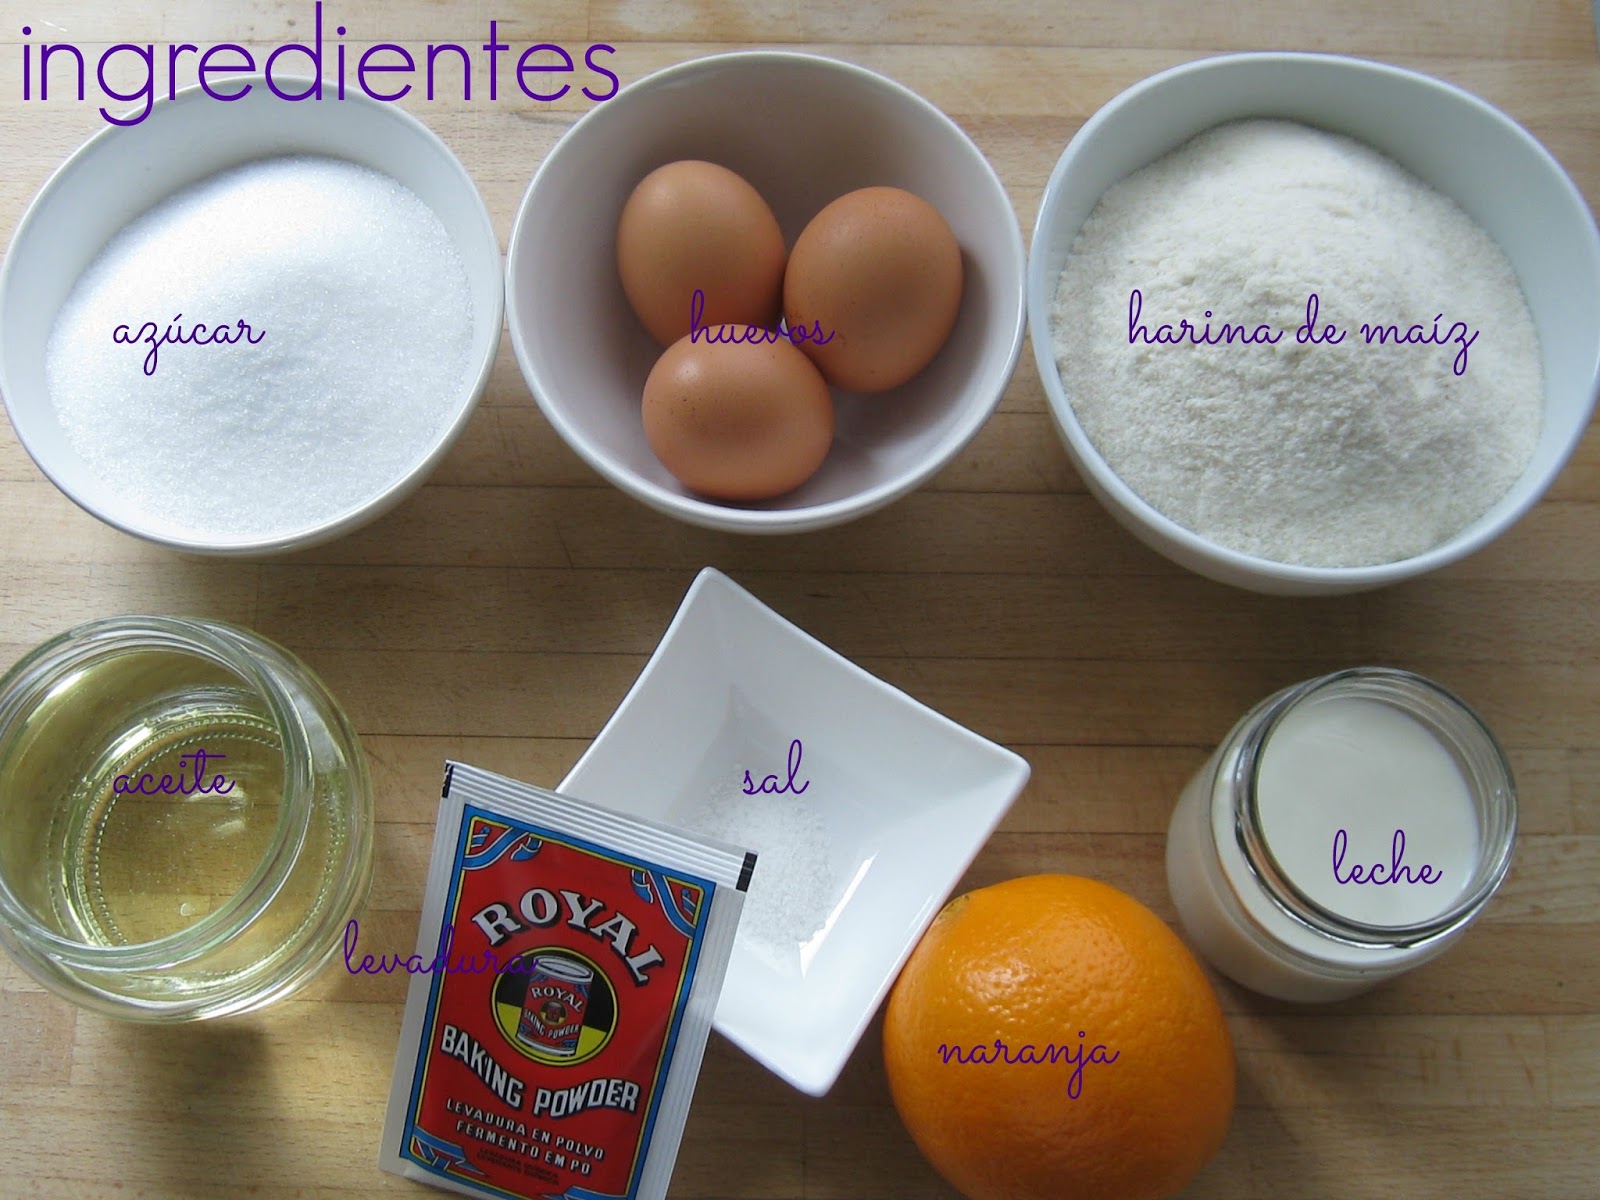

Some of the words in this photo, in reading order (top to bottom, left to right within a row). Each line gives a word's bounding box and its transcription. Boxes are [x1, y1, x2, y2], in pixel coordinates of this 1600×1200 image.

[472, 888, 665, 983] ROYAL
[531, 986, 583, 1013] ROYAL
[440, 1024, 525, 1109] BAKING
[532, 1078, 641, 1118] POWDER
[446, 1097, 526, 1136] LEVADURA
[532, 1128, 551, 1144] EN
[555, 1136, 605, 1160] POLVO
[456, 1119, 540, 1159] FERMENTO
[544, 1150, 565, 1168] EM
[570, 1161, 592, 1176] PO
